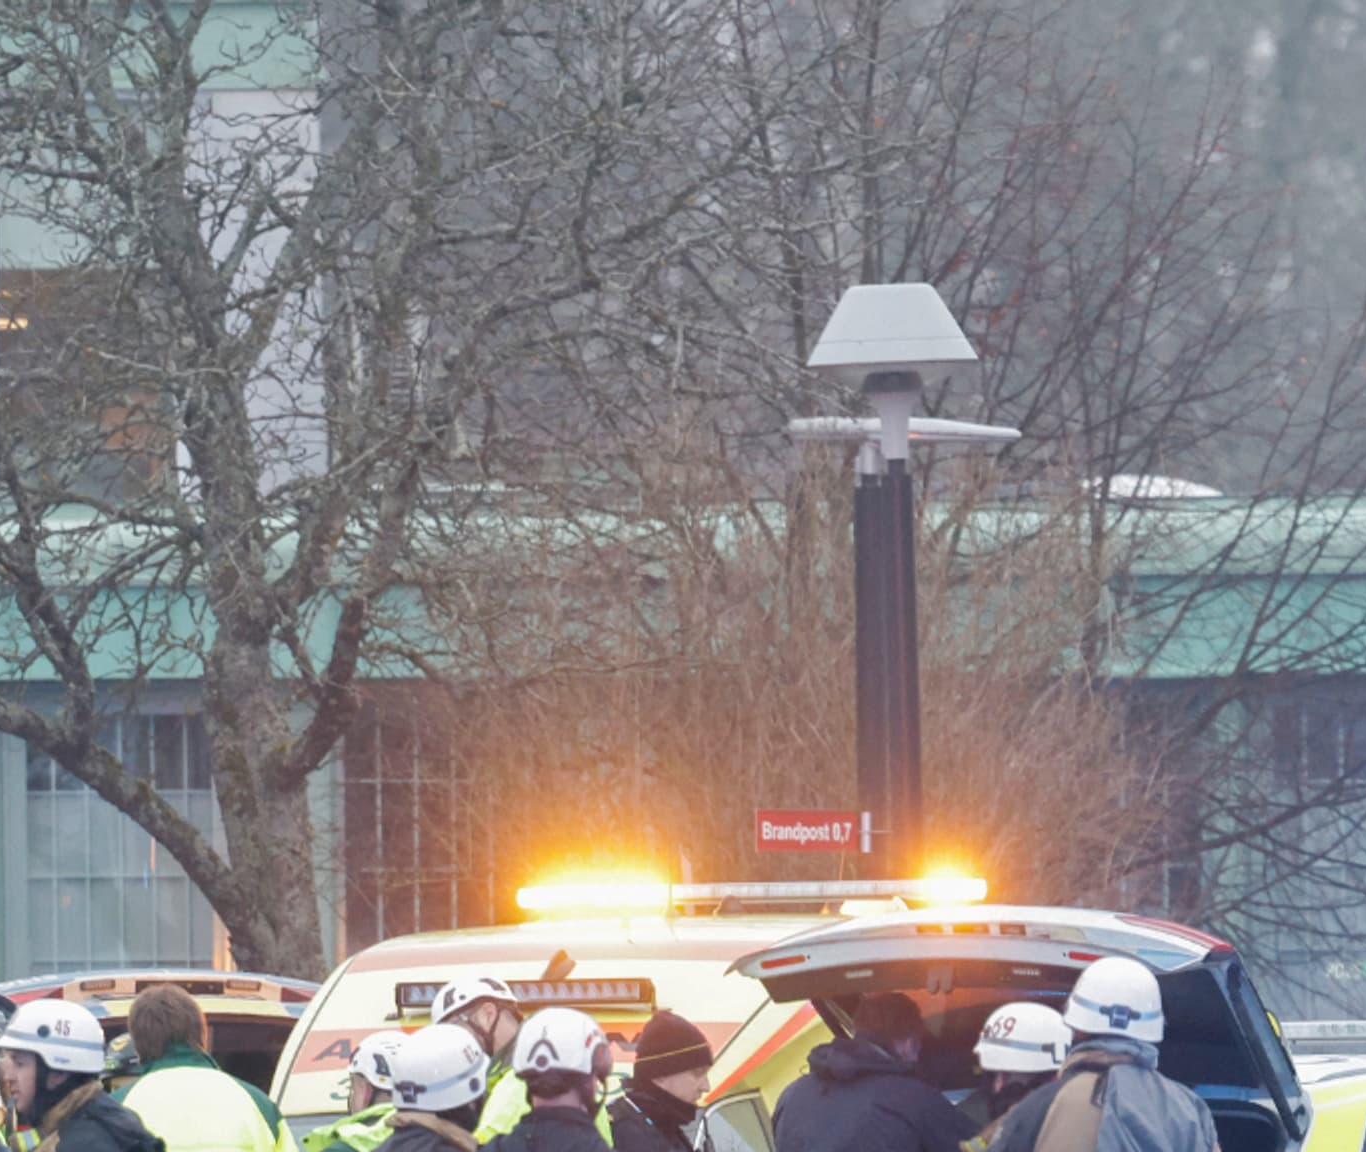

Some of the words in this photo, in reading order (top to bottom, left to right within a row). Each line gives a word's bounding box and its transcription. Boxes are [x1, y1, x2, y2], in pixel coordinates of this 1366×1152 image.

[762, 821, 830, 845] Brandpost
[832, 822, 852, 844] 0,7
[55, 1018, 71, 1037] 45
